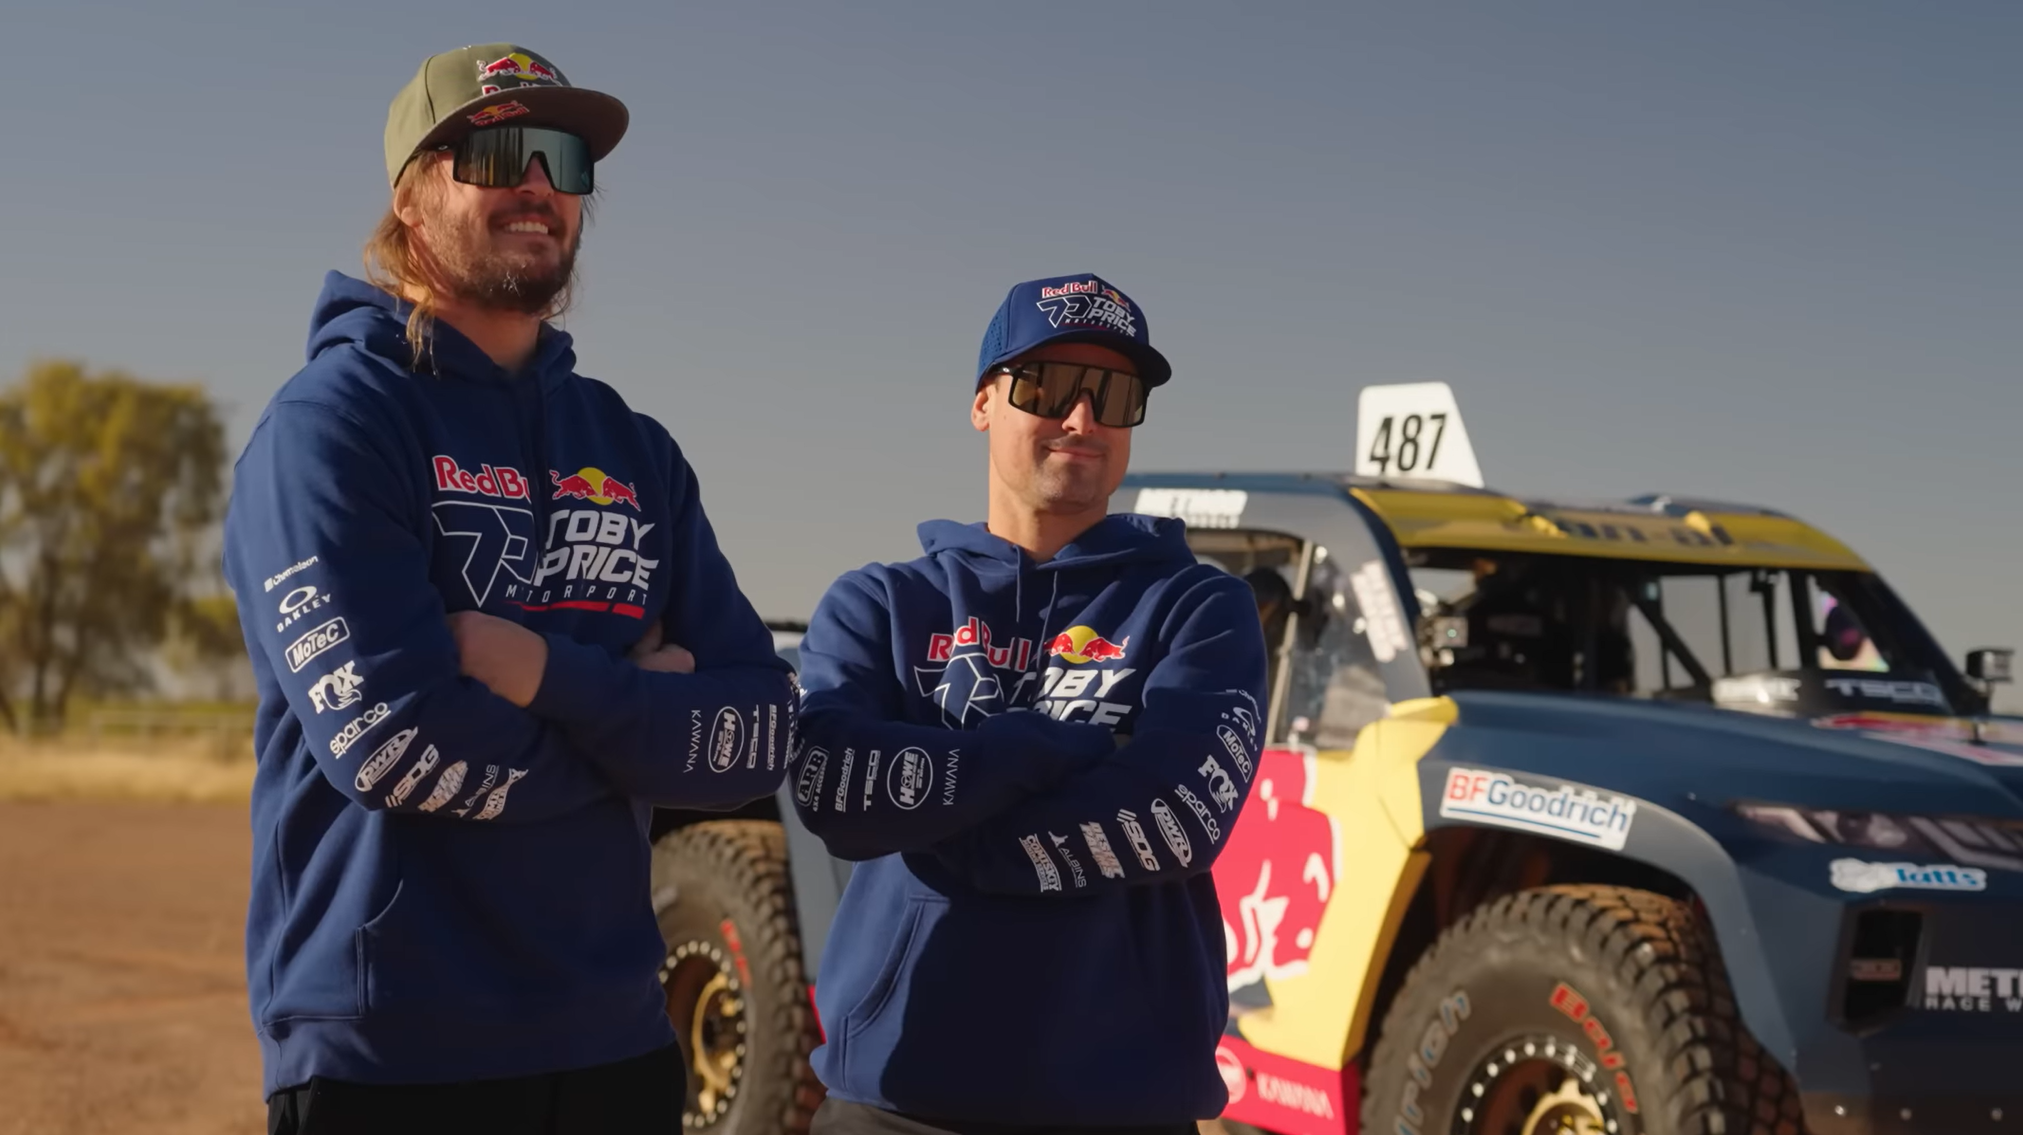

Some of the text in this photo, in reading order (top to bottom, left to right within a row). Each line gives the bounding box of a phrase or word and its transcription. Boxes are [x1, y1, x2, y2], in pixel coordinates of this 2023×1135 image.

[1041, 280, 1098, 299] Red Bull
[1092, 296, 1135, 322] TOBY
[1087, 308, 1137, 337] PRICE
[1369, 413, 1448, 473] 487
[432, 455, 532, 504] Red Bu
[545, 509, 656, 551] TOBY
[532, 544, 660, 591] PRICE
[276, 593, 332, 633] OAKLEY
[505, 584, 648, 606] MTORPORT
[291, 622, 340, 668] MoTeC
[926, 615, 980, 662] Rd
[308, 660, 365, 714] FOX
[329, 701, 389, 756] sparco
[1006, 699, 1133, 733] ICE
[358, 735, 405, 791] PWR
[683, 708, 702, 774] KAWANA
[1222, 729, 1251, 775] MoTeC
[393, 743, 440, 800] SDG
[464, 764, 497, 808] AINS
[799, 750, 827, 800] ARB
[834, 747, 853, 813] BFGoodrich
[863, 750, 878, 812] TSCO
[900, 751, 916, 806] HOWE
[943, 748, 960, 806] KAWANA
[1197, 754, 1239, 812] FOX
[1177, 783, 1221, 841] sparco
[1447, 773, 1629, 832] BFGoodrich
[1123, 820, 1161, 872] SDG
[1152, 806, 1189, 855] PWR
[1026, 834, 1060, 891] COMISKEY
[1059, 847, 1087, 888] ALBINS
[1925, 997, 1993, 1013] RACE
[1926, 966, 2023, 998] MET
[1550, 981, 1638, 1114] Baja
